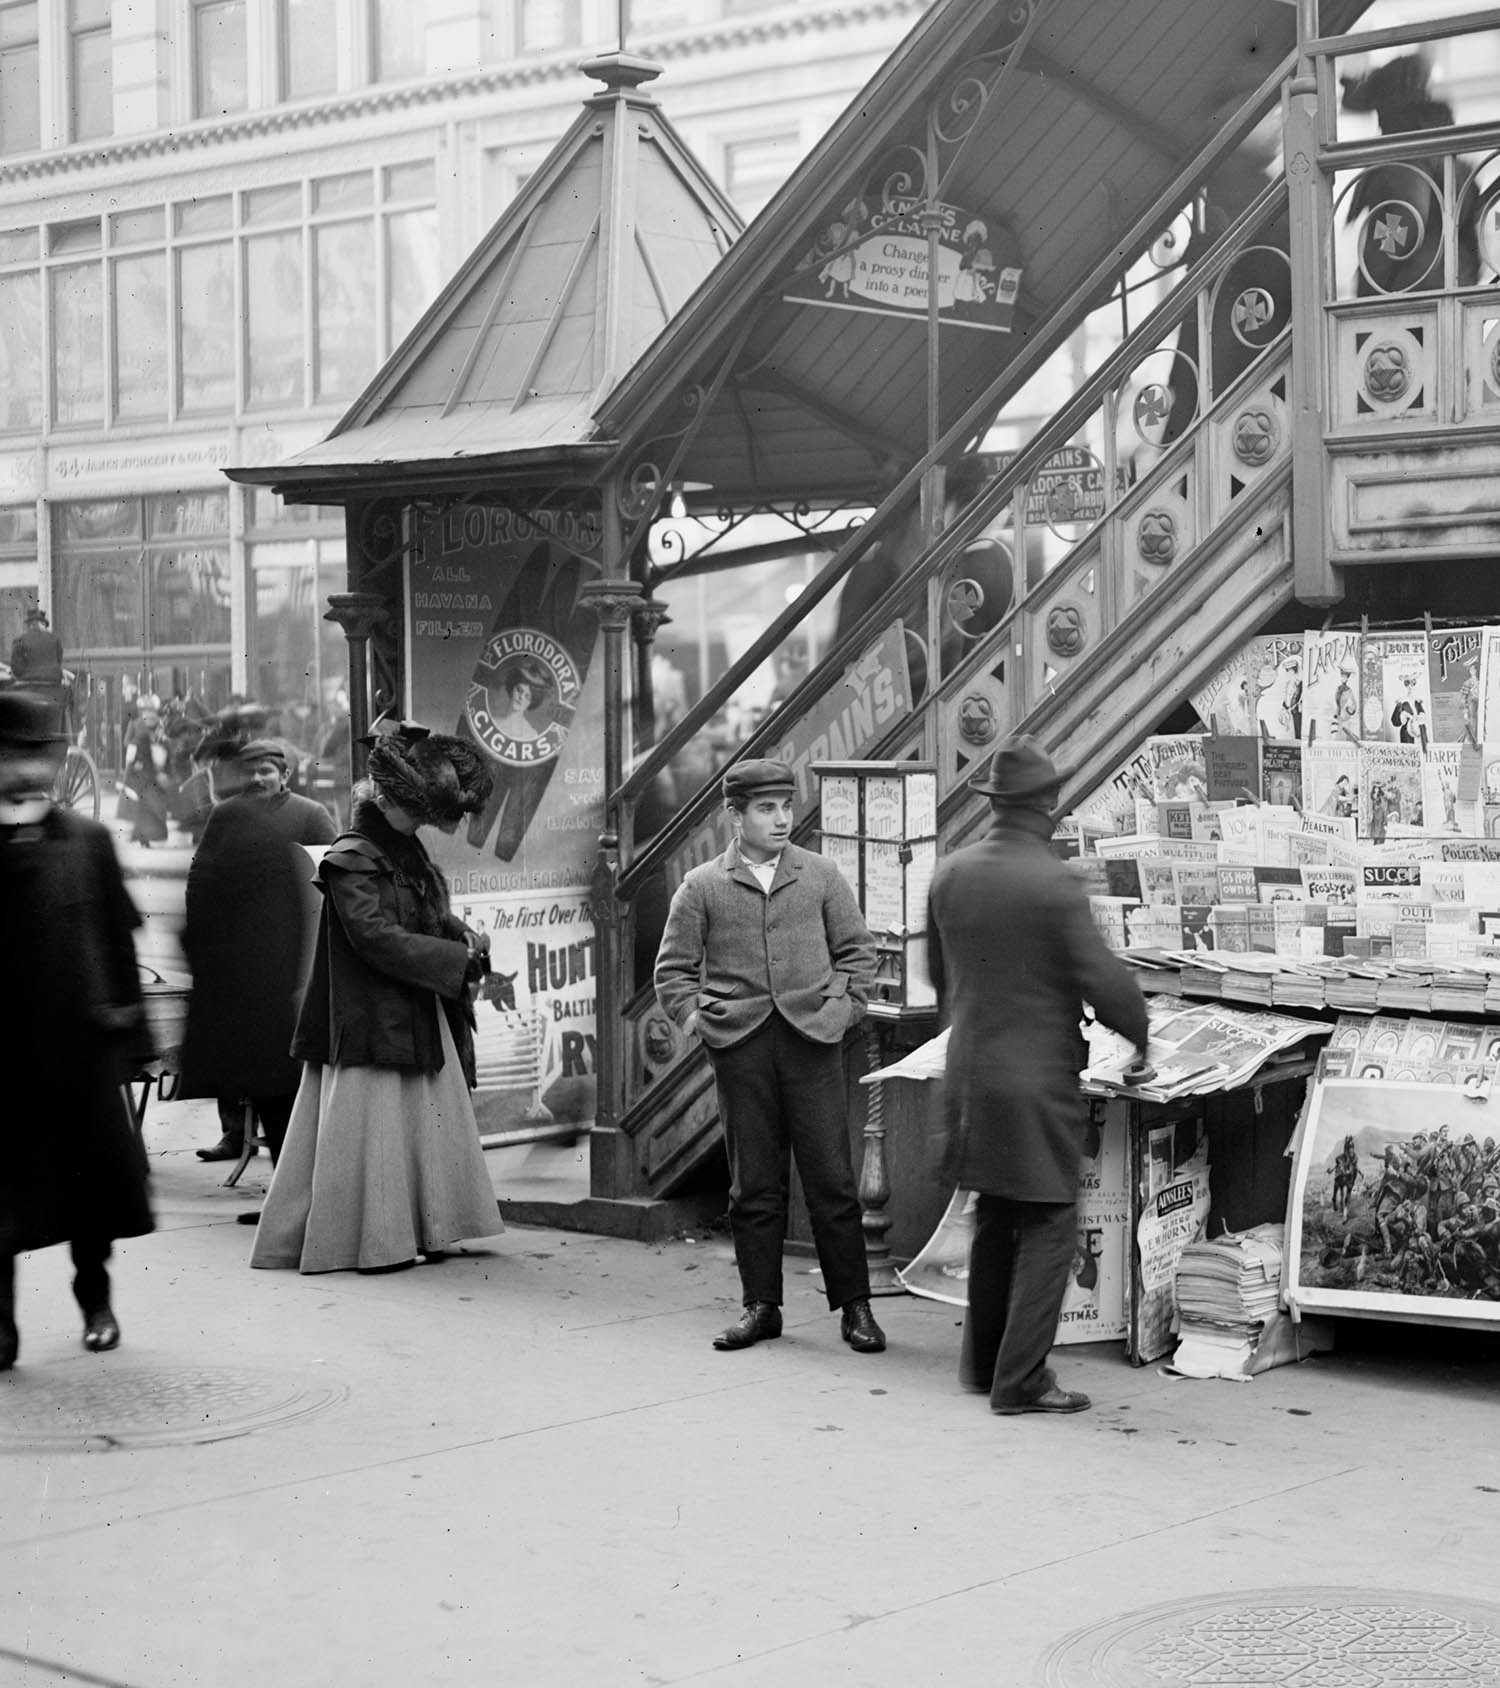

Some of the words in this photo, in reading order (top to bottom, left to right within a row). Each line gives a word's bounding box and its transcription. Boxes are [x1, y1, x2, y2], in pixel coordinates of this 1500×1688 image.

[860, 263, 866, 271] a
[872, 263, 905, 276] prosy
[909, 267, 951, 283] diner
[866, 279, 889, 292] into
[892, 283, 898, 293] a
[432, 566, 471, 582] ALL
[415, 592, 492, 609] HAVANA
[415, 620, 484, 636] FILLER
[492, 634, 577, 693] FLORODORA
[473, 711, 551, 761] CIGARS
[1371, 757, 1421, 768] COMPANIO
[1443, 764, 1460, 778] WE
[869, 786, 900, 805] ADAMS
[1301, 815, 1335, 835] HEALTH
[1441, 844, 1479, 862] POLICE
[467, 869, 528, 893] ENOUGH
[532, 871, 559, 889] FOR
[515, 905, 545, 928] First
[549, 904, 576, 924] Over
[1401, 907, 1433, 918] OUTI
[527, 937, 597, 994] HUNT
[561, 1031, 597, 1078] RY
[1077, 1213, 1128, 1225] RISTMAS
[1059, 1309, 1099, 1322] ISTMAS
